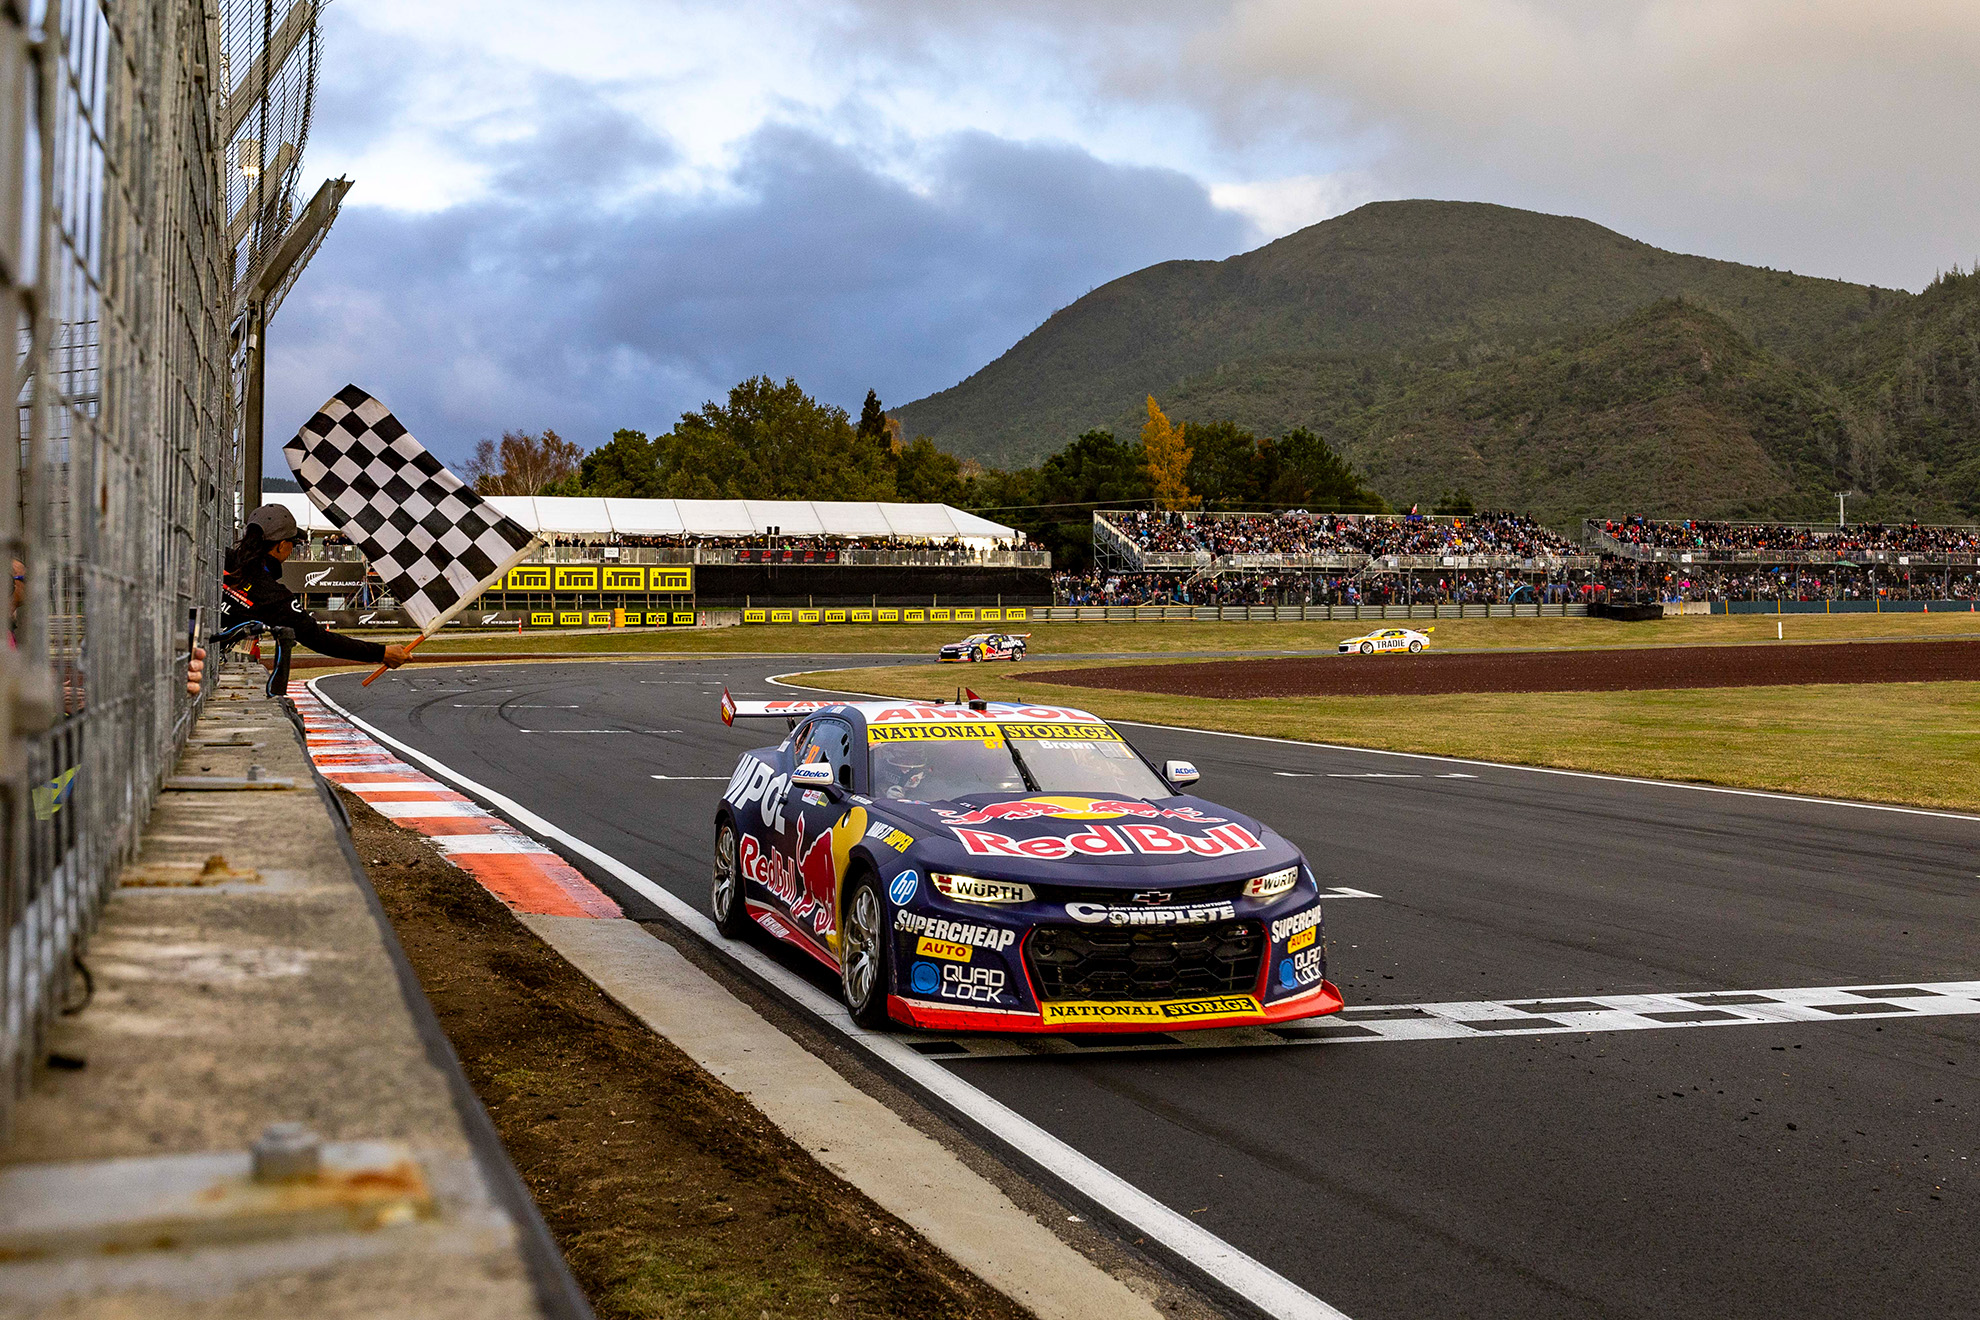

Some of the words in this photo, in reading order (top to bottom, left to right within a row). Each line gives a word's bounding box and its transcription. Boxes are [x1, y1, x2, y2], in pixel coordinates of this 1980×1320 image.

[1377, 639, 1405, 648] TRADIE
[874, 708, 1096, 722] AMPOL
[869, 725, 995, 740] NATIONAL
[1004, 725, 1112, 740] STORAGE
[985, 740, 1004, 749] 87
[1042, 740, 1094, 750] Brown
[794, 769, 829, 778] ACDelco
[883, 829, 914, 853] SUPER
[948, 824, 1134, 860] Red
[1118, 822, 1266, 858] Bull
[892, 874, 916, 904] hp
[956, 881, 1023, 900] WÜRTH
[1065, 902, 1236, 925] COMPLETE
[894, 909, 1016, 952] SUPERCHEAP
[1291, 932, 1312, 948] AUTO
[922, 942, 966, 957] AUTO
[1294, 946, 1321, 970] QUAD
[944, 964, 1005, 987] QUAD
[941, 982, 1003, 1003] LOCK
[1050, 1006, 1160, 1016] NATIONAL
[1167, 1000, 1252, 1015] STORAGE
